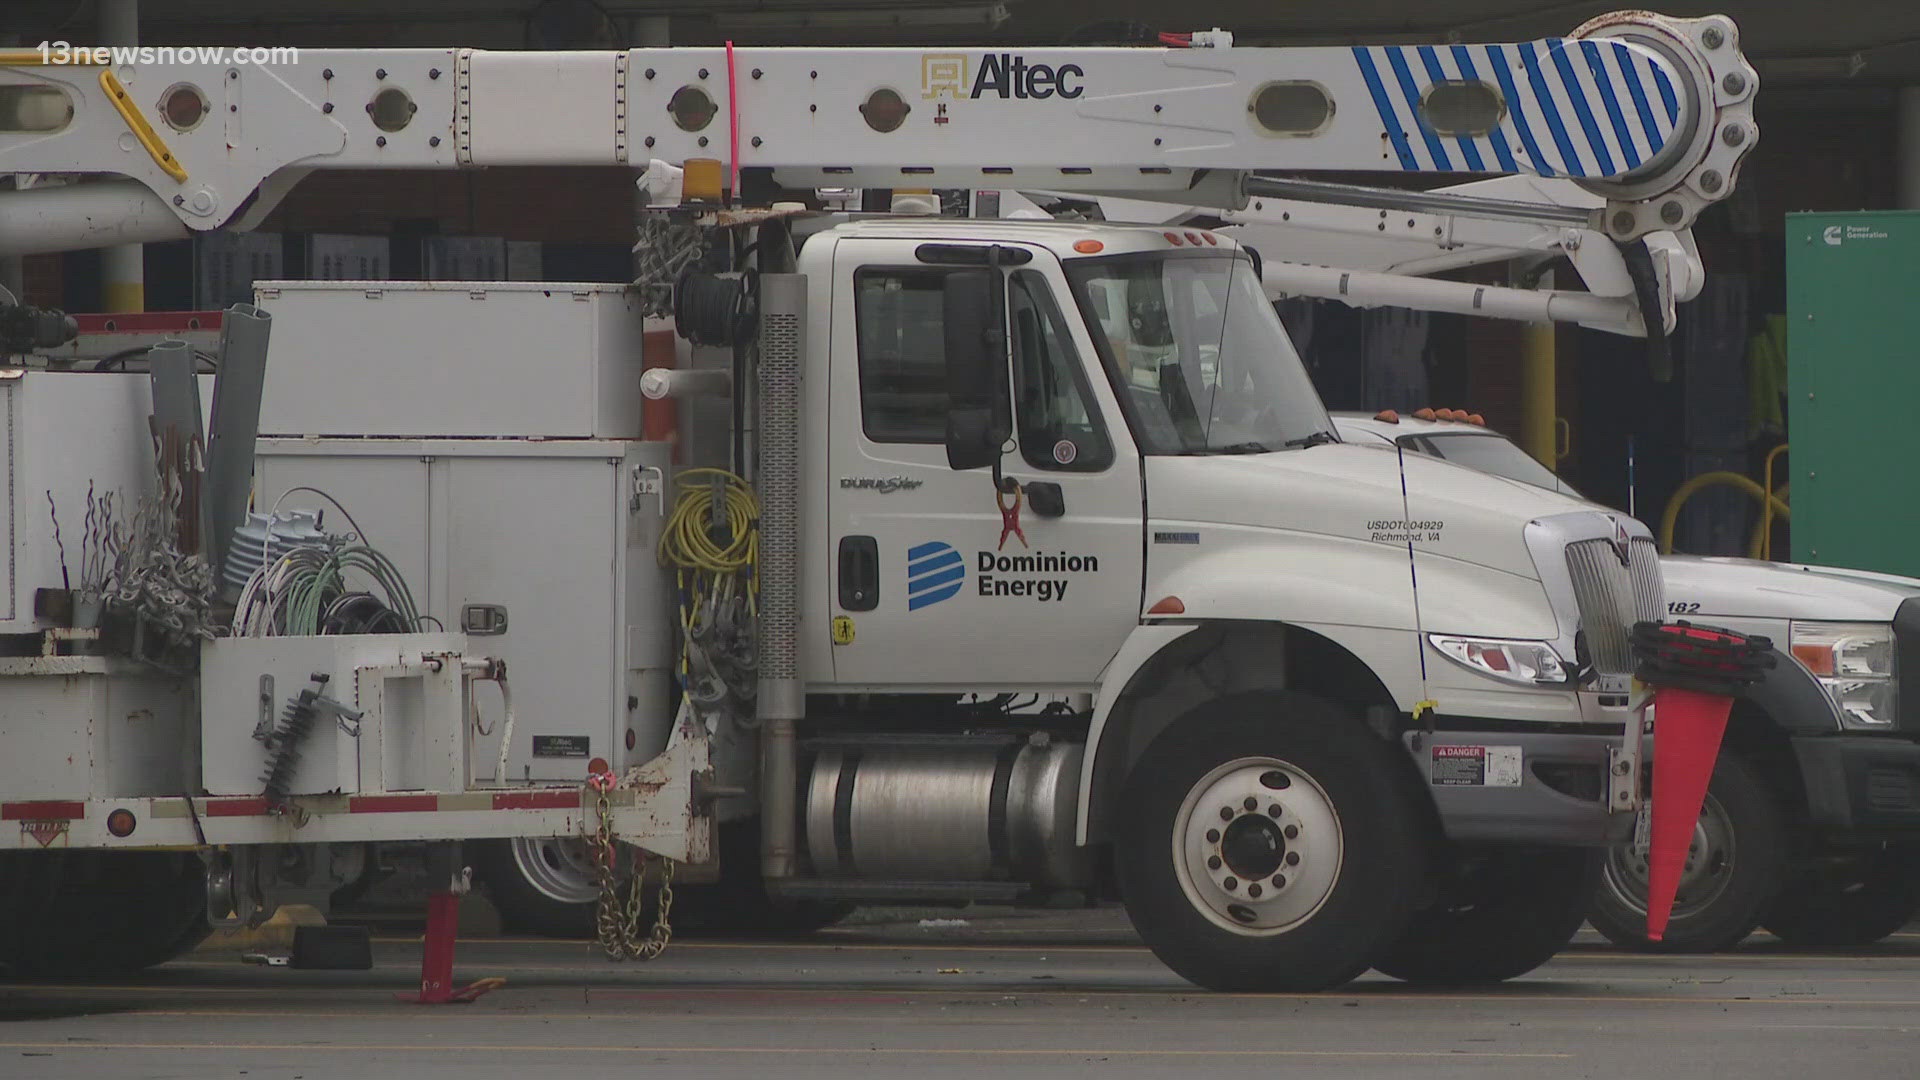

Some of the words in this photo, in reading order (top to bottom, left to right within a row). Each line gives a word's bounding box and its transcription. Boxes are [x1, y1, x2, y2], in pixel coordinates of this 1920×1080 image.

[970, 53, 1084, 100] Altec
[1846, 231, 1888, 239] Generation
[1371, 532, 1424, 542] Richmond,
[1428, 532, 1440, 541] VA
[977, 551, 1098, 572] Dominion
[978, 575, 1068, 602] Energy
[1667, 601, 1701, 614] 182
[1447, 748, 1480, 756] DANGER
